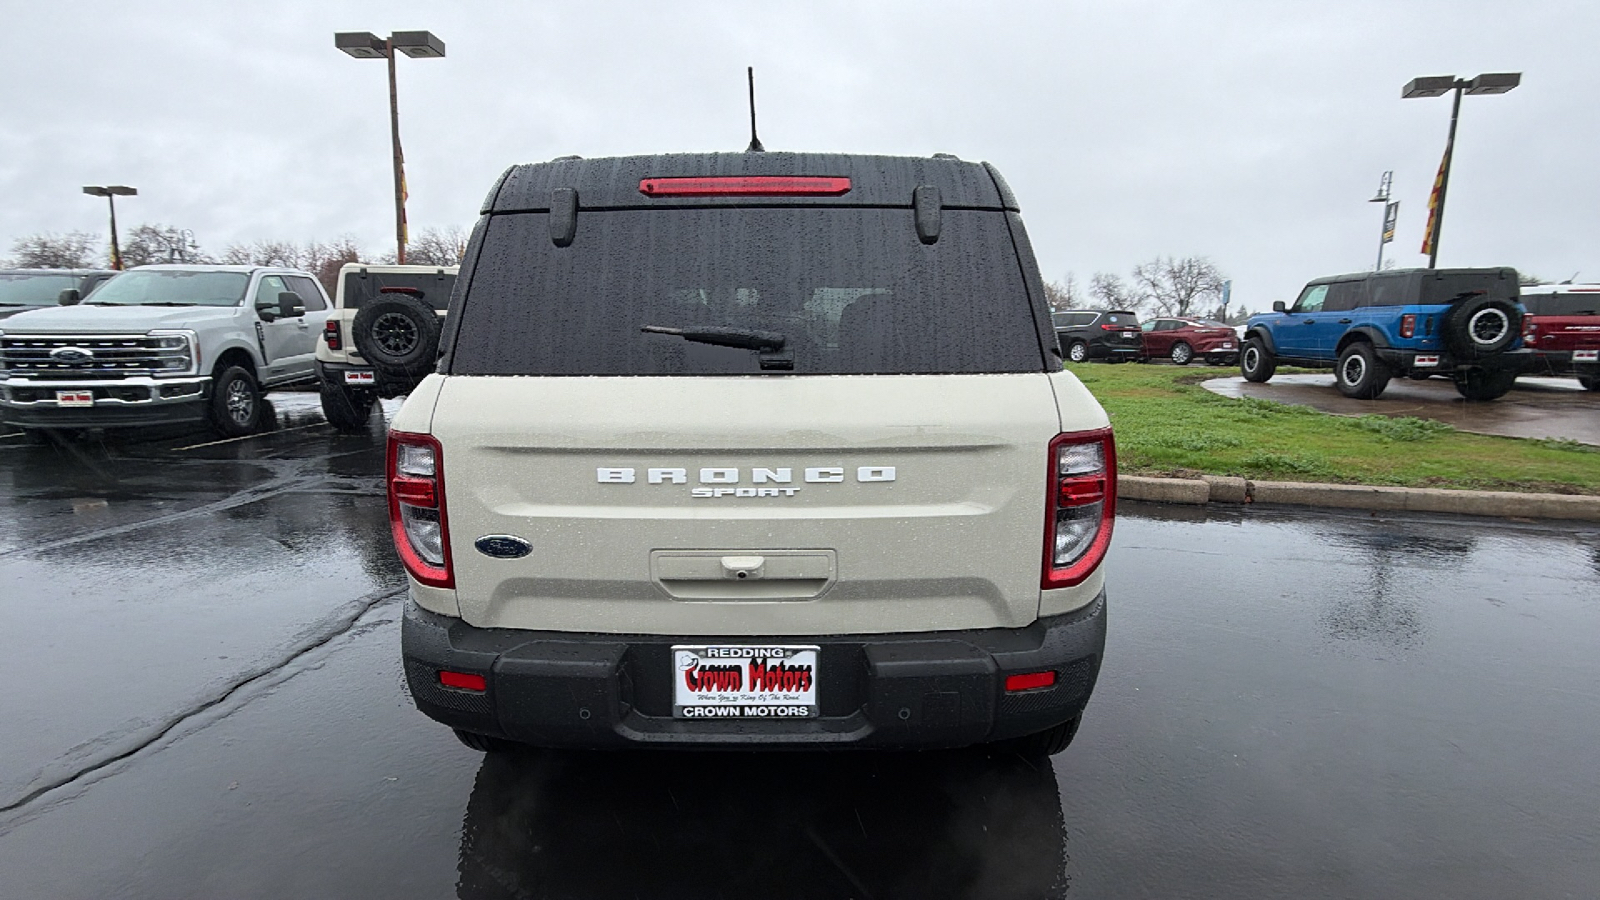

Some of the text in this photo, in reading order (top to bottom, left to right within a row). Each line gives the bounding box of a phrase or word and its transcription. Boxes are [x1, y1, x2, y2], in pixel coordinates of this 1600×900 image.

[597, 466, 896, 484] BRONCO
[691, 487, 801, 498] SPORT
[707, 648, 784, 658] REDDING
[684, 657, 812, 692] Crown Motors
[740, 694, 756, 702] King
[758, 694, 767, 703] Of
[768, 693, 781, 701] The
[683, 706, 809, 717] CROWN MOTORS
